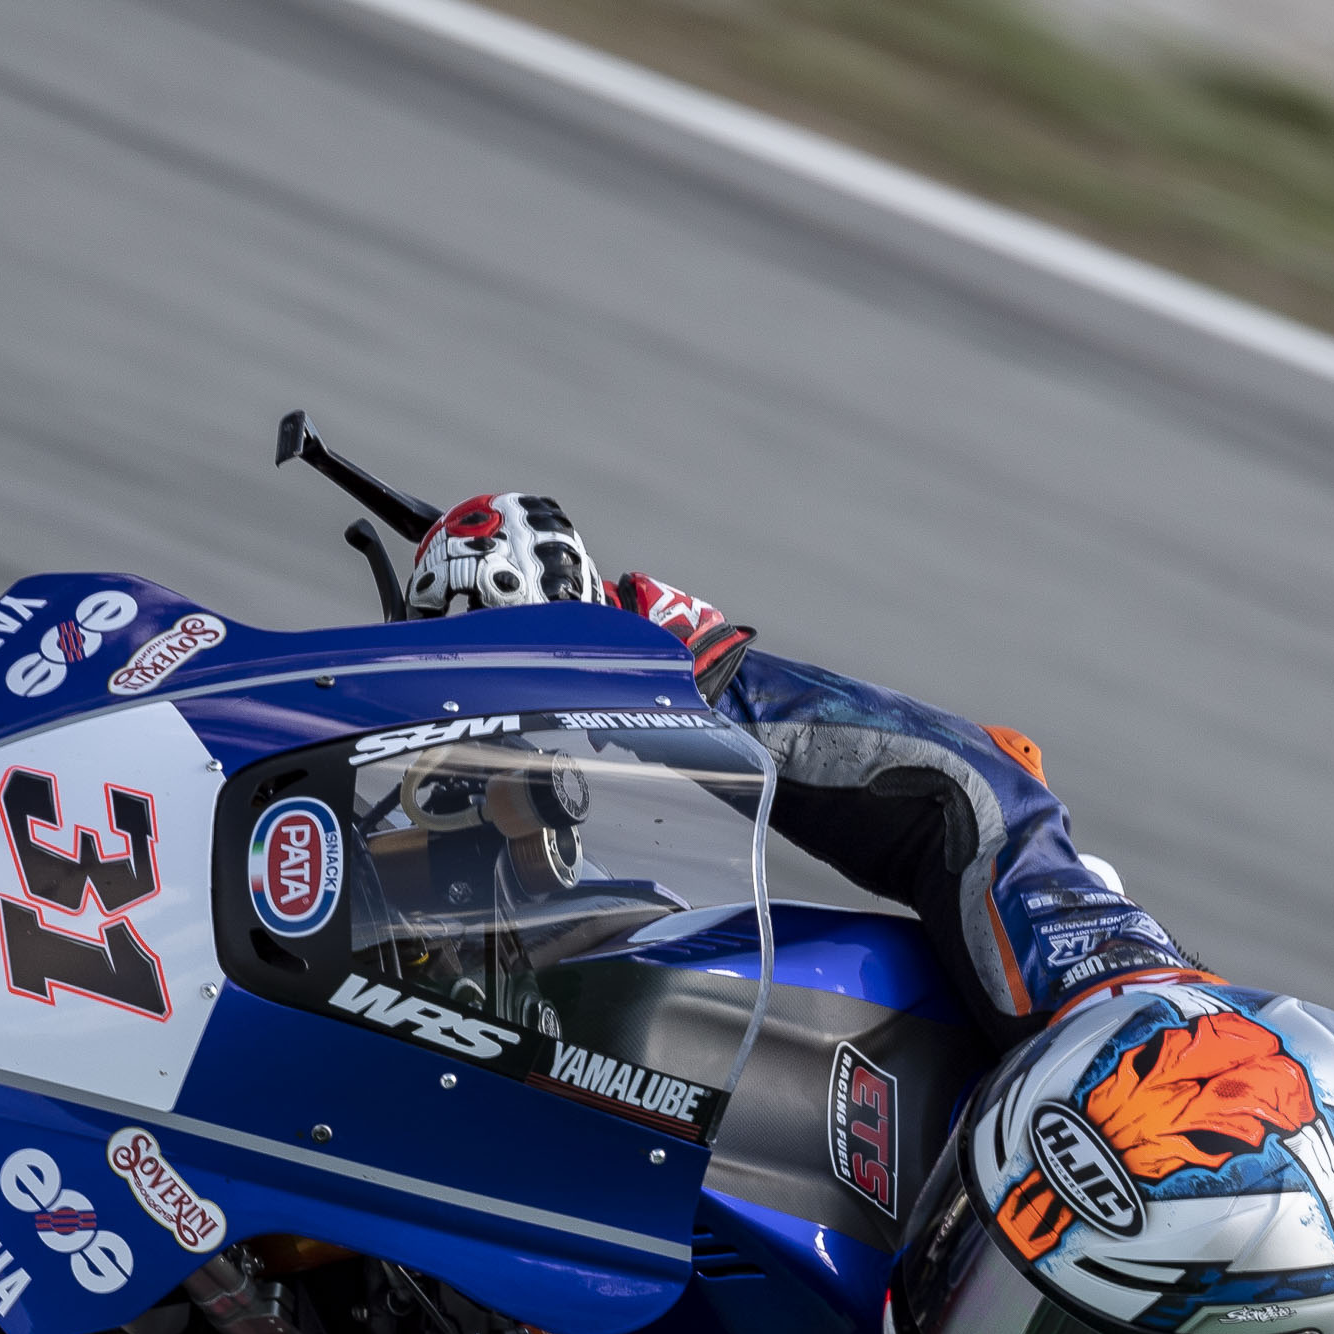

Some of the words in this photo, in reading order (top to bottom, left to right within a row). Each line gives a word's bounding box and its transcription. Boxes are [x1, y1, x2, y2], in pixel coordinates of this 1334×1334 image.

[348, 713, 521, 766] WRS
[554, 712, 717, 731] YAMALUBE
[279, 823, 315, 906] PATA
[323, 831, 340, 892] SNACK
[328, 973, 522, 1060] WRS
[547, 1040, 705, 1123] YAMALUBE
[835, 1127, 852, 1179] FUELS
[851, 1065, 889, 1205] ETS
[1036, 1118, 1136, 1218] HJC
[113, 1133, 220, 1247] SOVERINI
